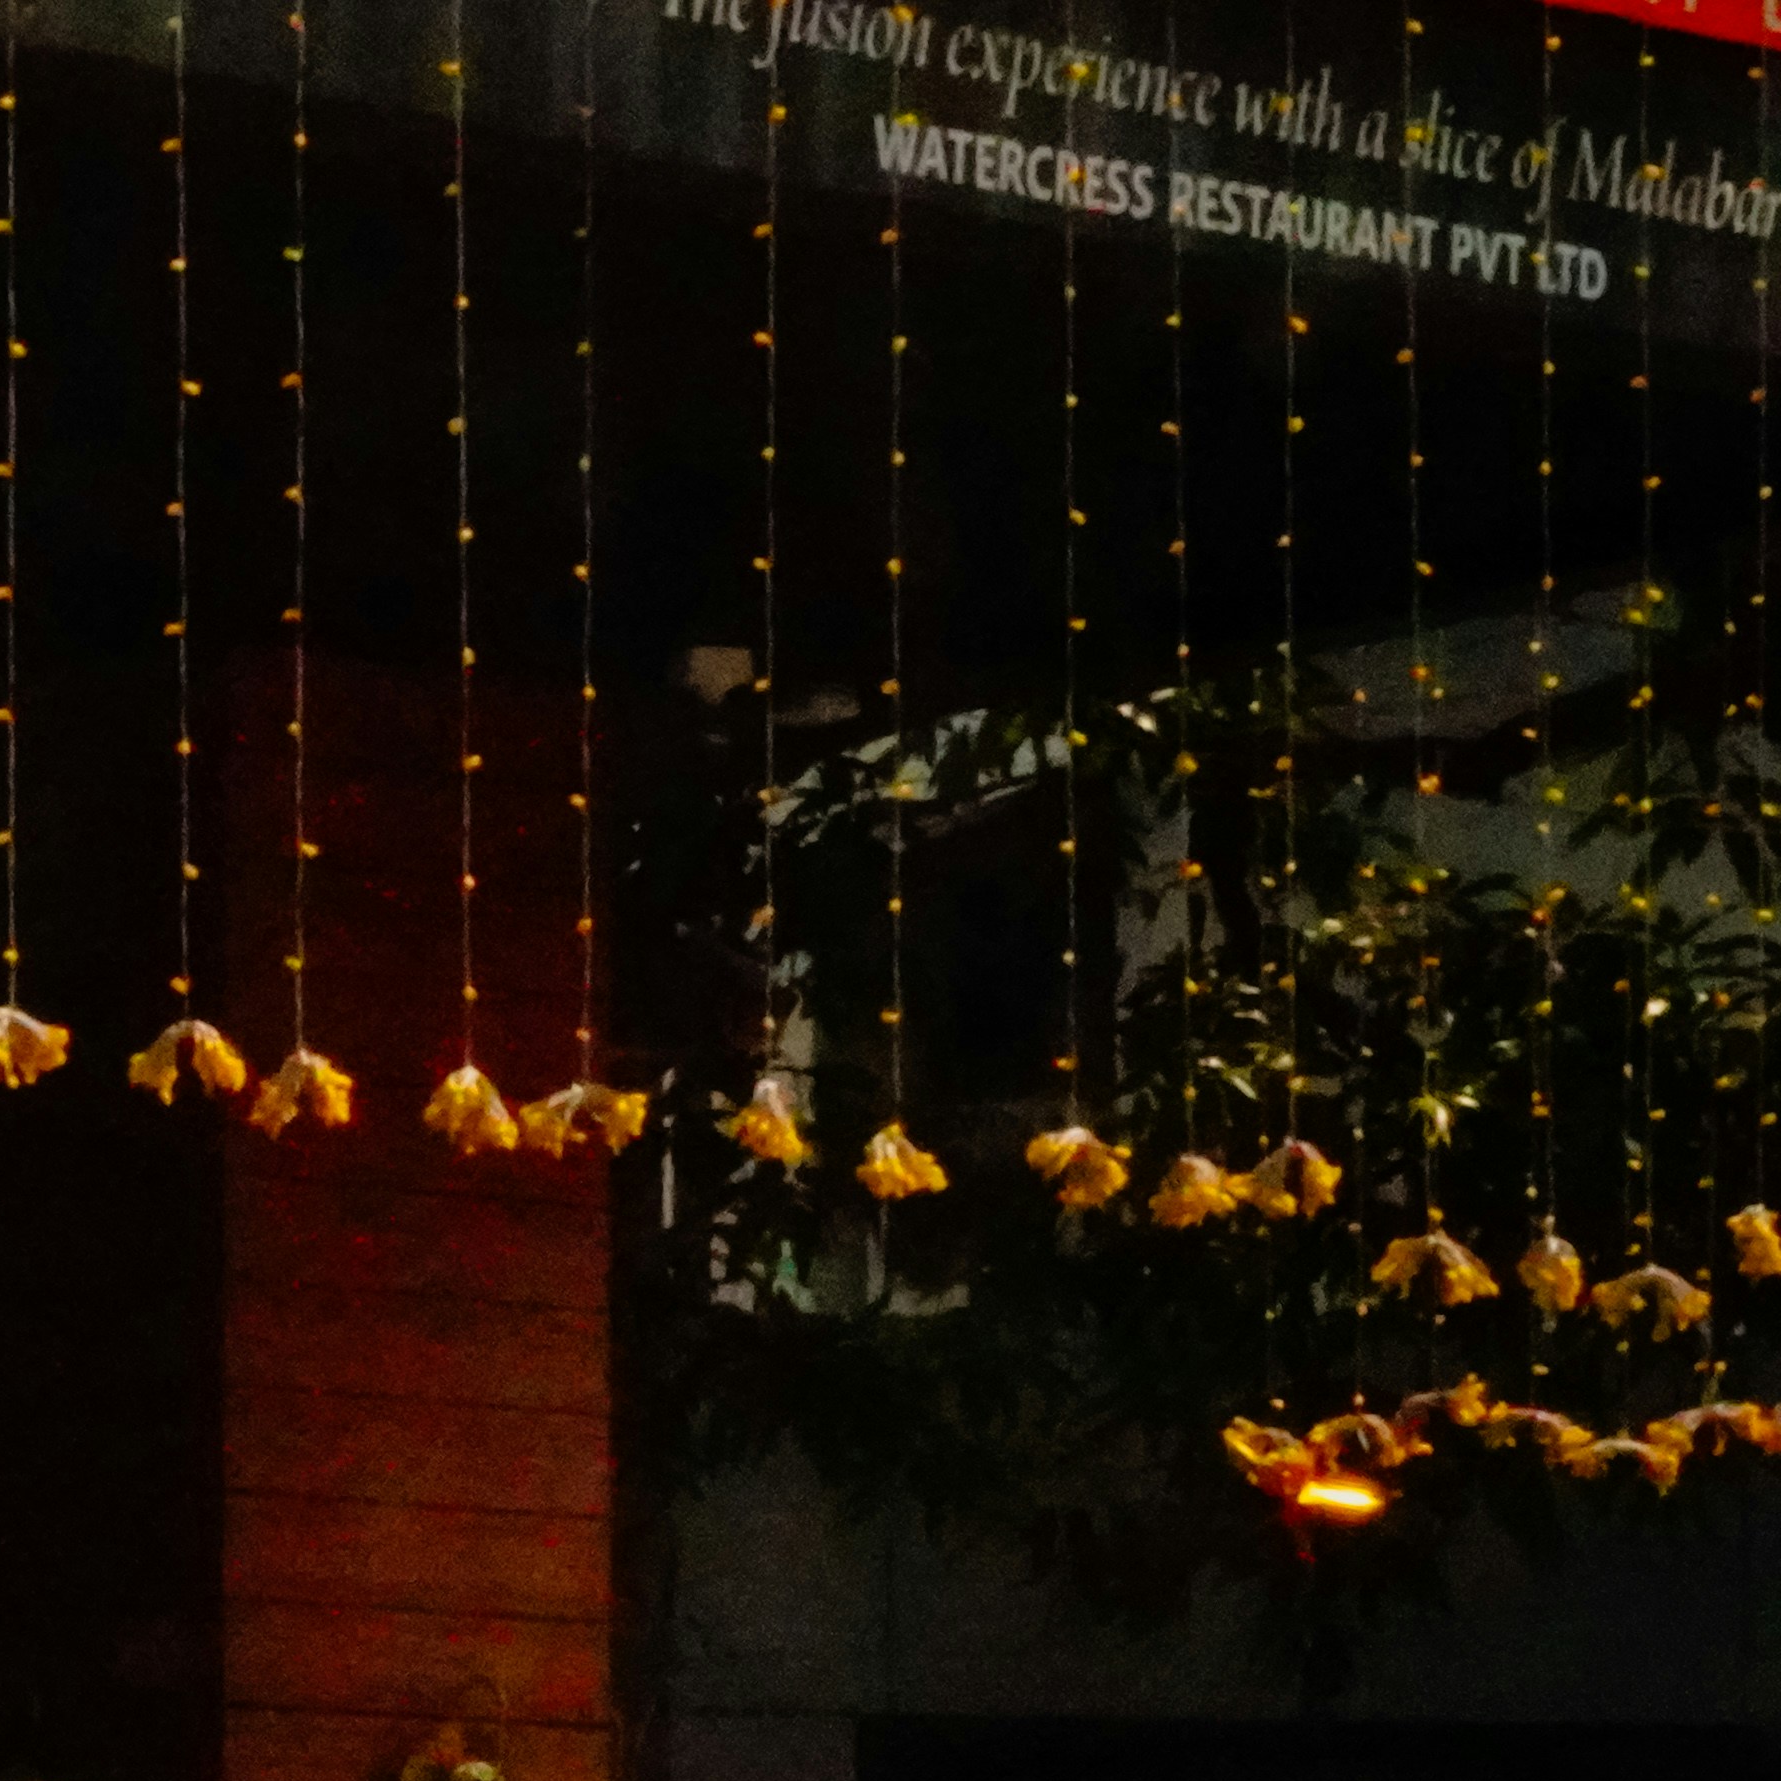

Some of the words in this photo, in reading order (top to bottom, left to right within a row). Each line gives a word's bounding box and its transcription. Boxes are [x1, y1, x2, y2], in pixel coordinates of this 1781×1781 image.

[874, 113, 1155, 220] WATERCRESS
[1168, 170, 1439, 271] RESTAURANT
[1449, 223, 1527, 286] PVT
[1537, 238, 1608, 300] LTD
[946, 25, 1222, 126] experience
[1235, 62, 1343, 153] with
[1354, 110, 1388, 161] a
[1398, 88, 1503, 183] slice
[1510, 116, 1568, 224] of
